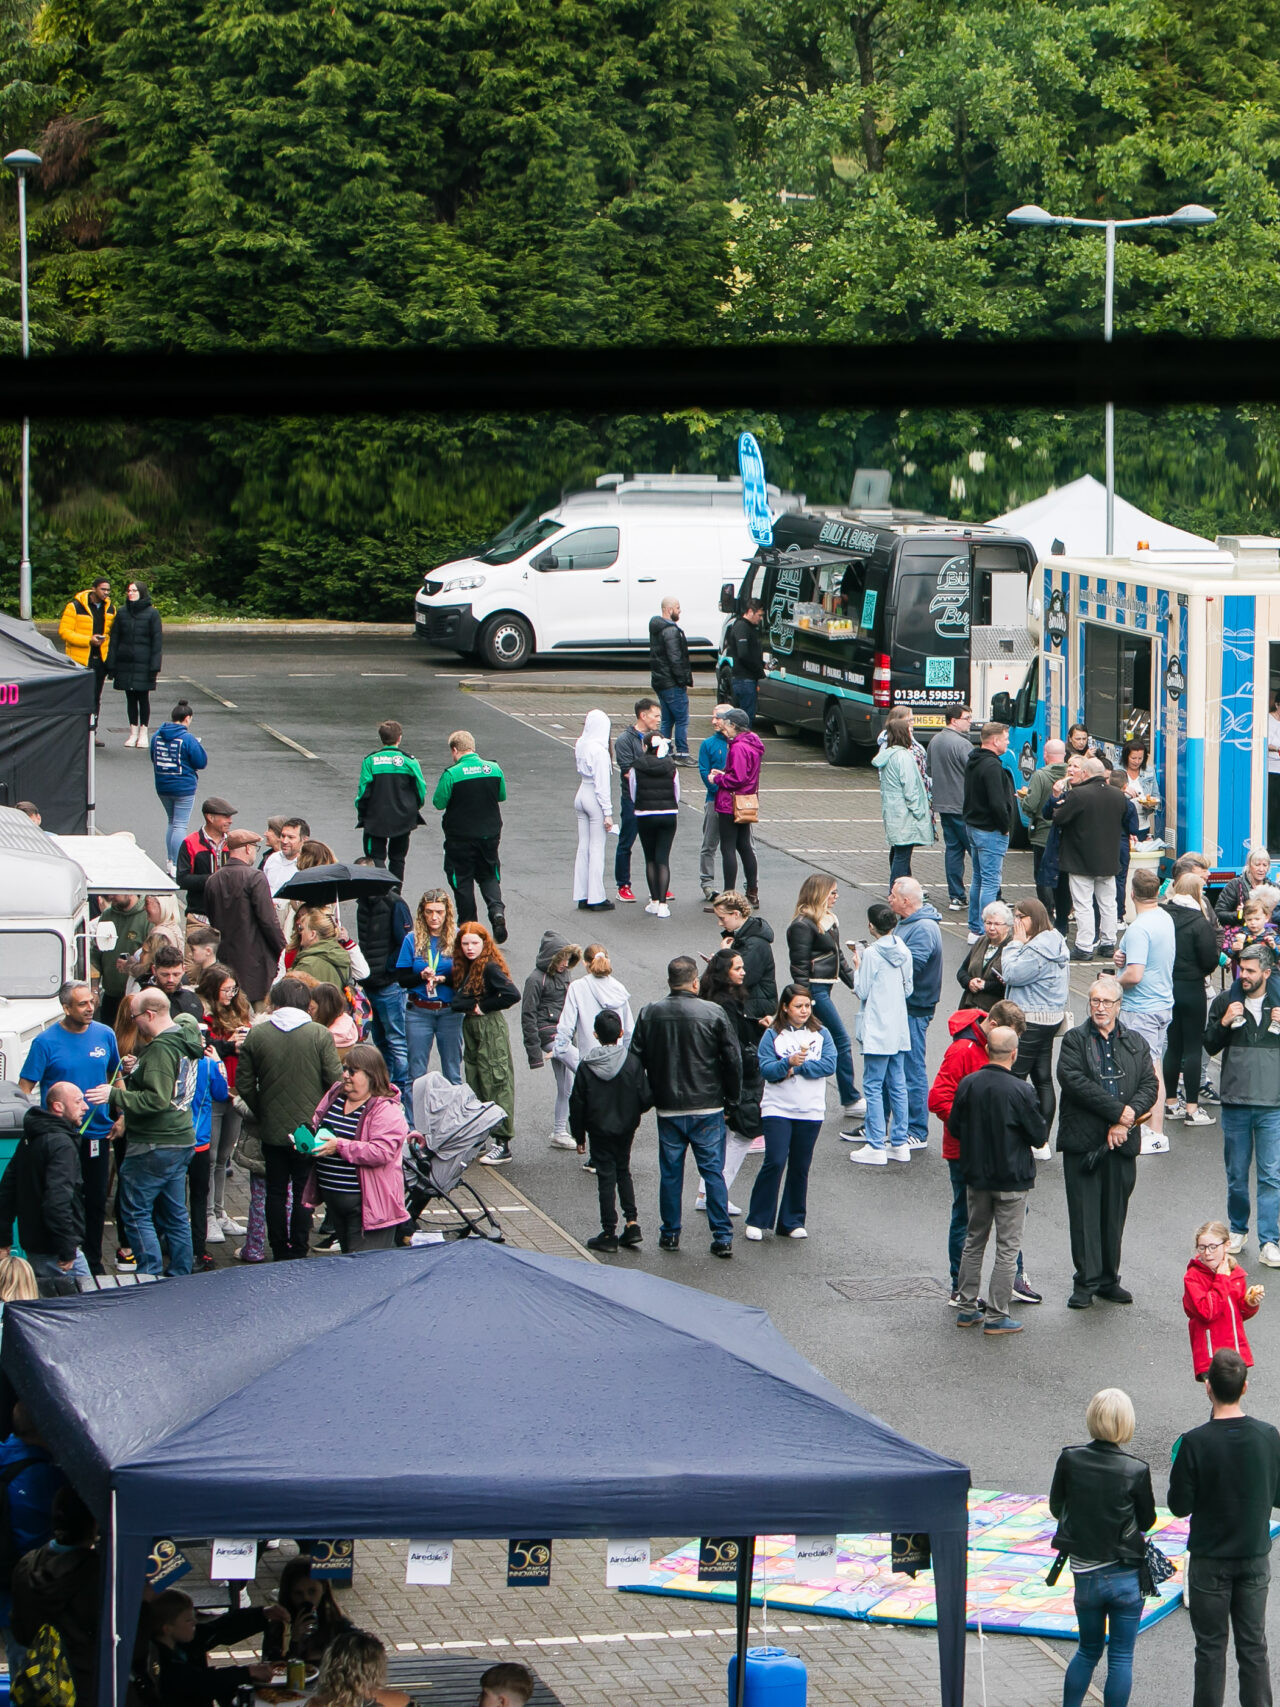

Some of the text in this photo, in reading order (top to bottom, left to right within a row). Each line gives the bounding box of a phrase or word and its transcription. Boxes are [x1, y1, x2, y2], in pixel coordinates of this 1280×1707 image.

[894, 689, 965, 700] 01384 598551
[509, 1541, 550, 1570] 50
[700, 1537, 739, 1565] 50
[797, 1549, 830, 1559] Airedale
[410, 1552, 444, 1562] Airedale
[609, 1555, 642, 1564] Airedale
